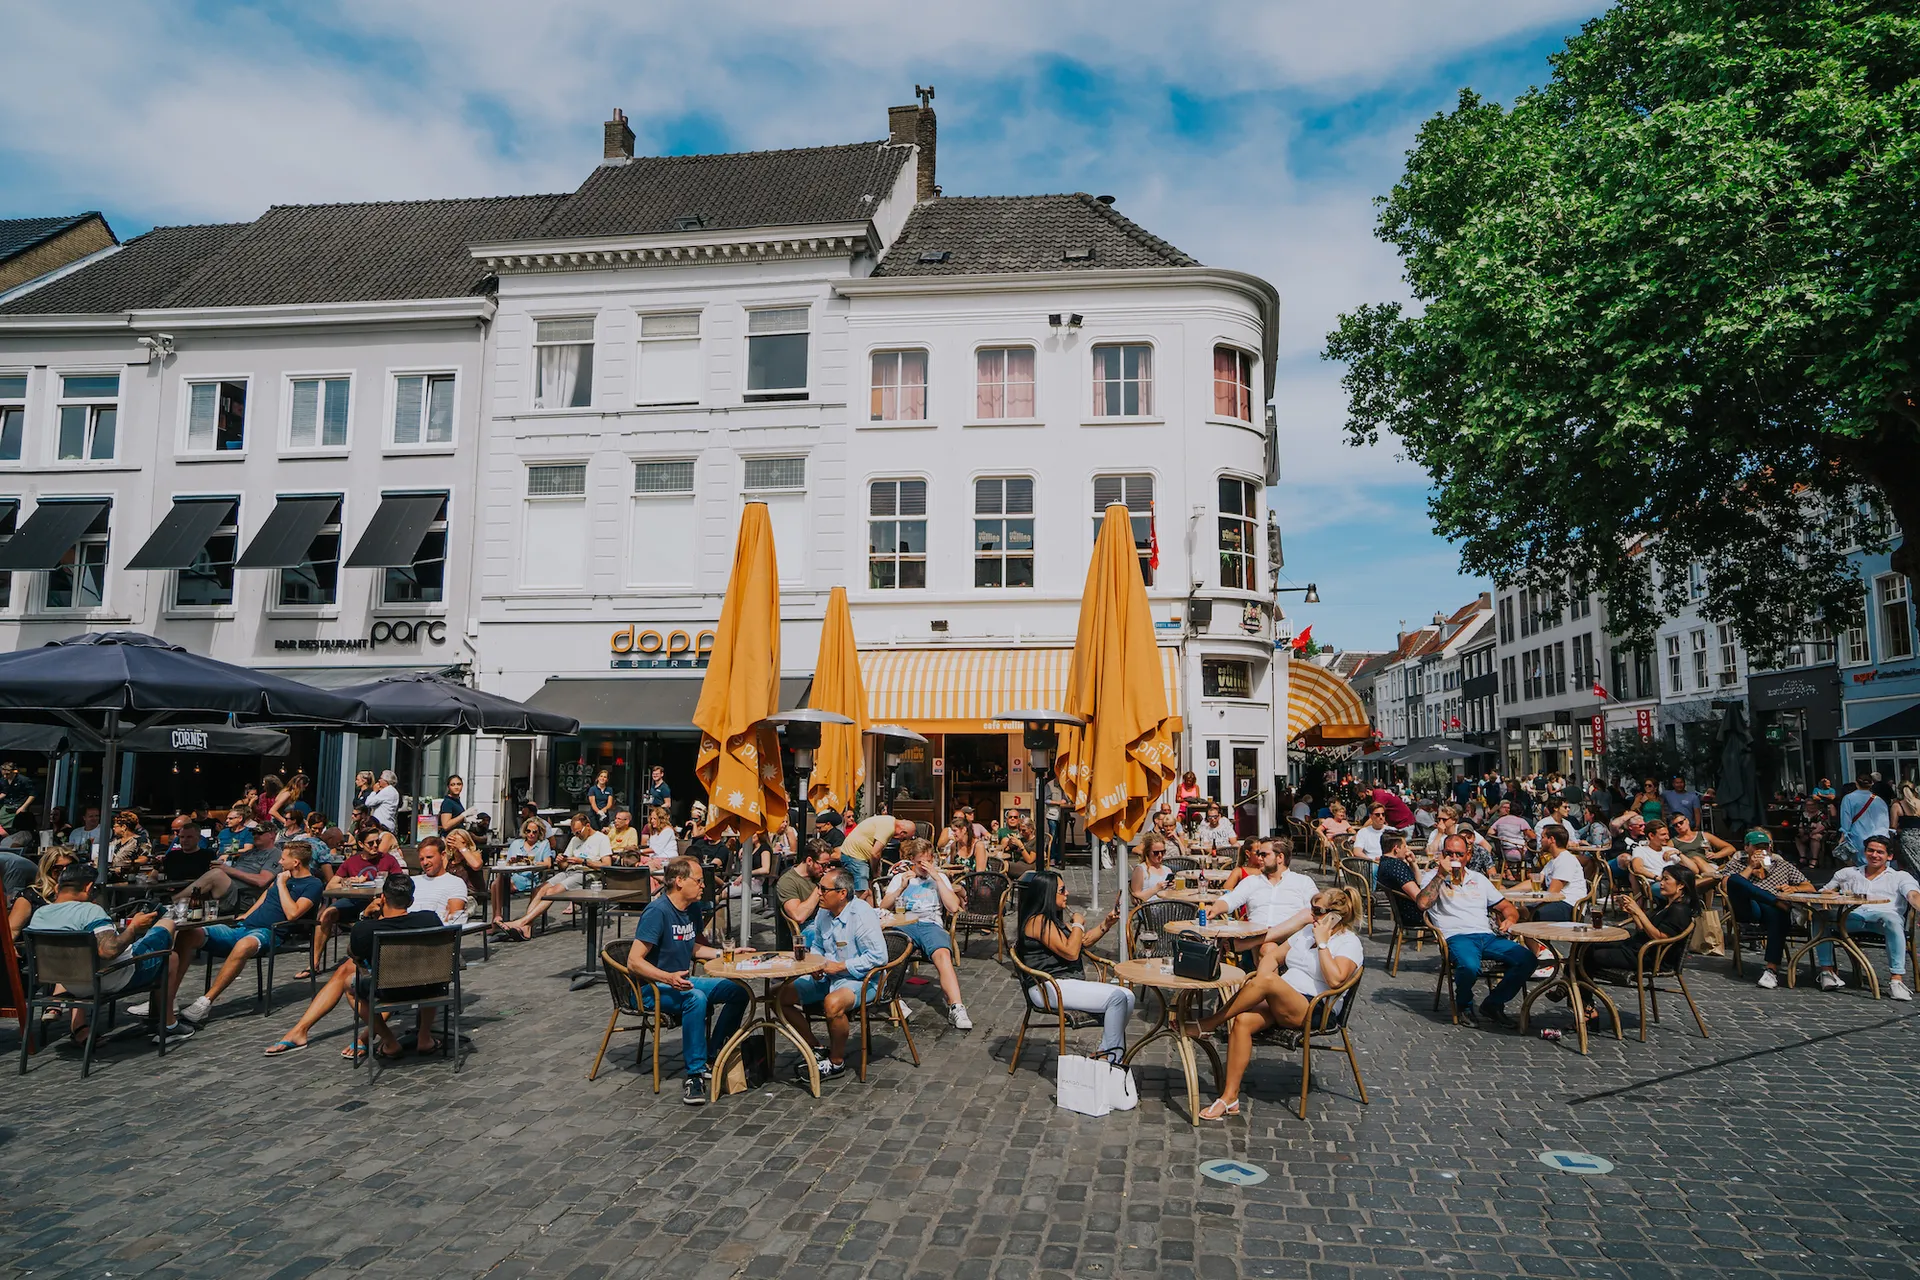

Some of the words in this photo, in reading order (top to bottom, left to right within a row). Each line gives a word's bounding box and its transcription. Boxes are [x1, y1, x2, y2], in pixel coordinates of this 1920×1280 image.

[275, 640, 297, 650] BAR
[298, 639, 368, 649] RESTAURANT
[370, 621, 447, 650] parc
[610, 624, 717, 658] dopp
[612, 660, 698, 668] ESPRE
[983, 719, 1000, 730] café
[1003, 720, 1025, 730] vullin
[171, 730, 208, 749] CORNET
[1100, 782, 1127, 809] vulli
